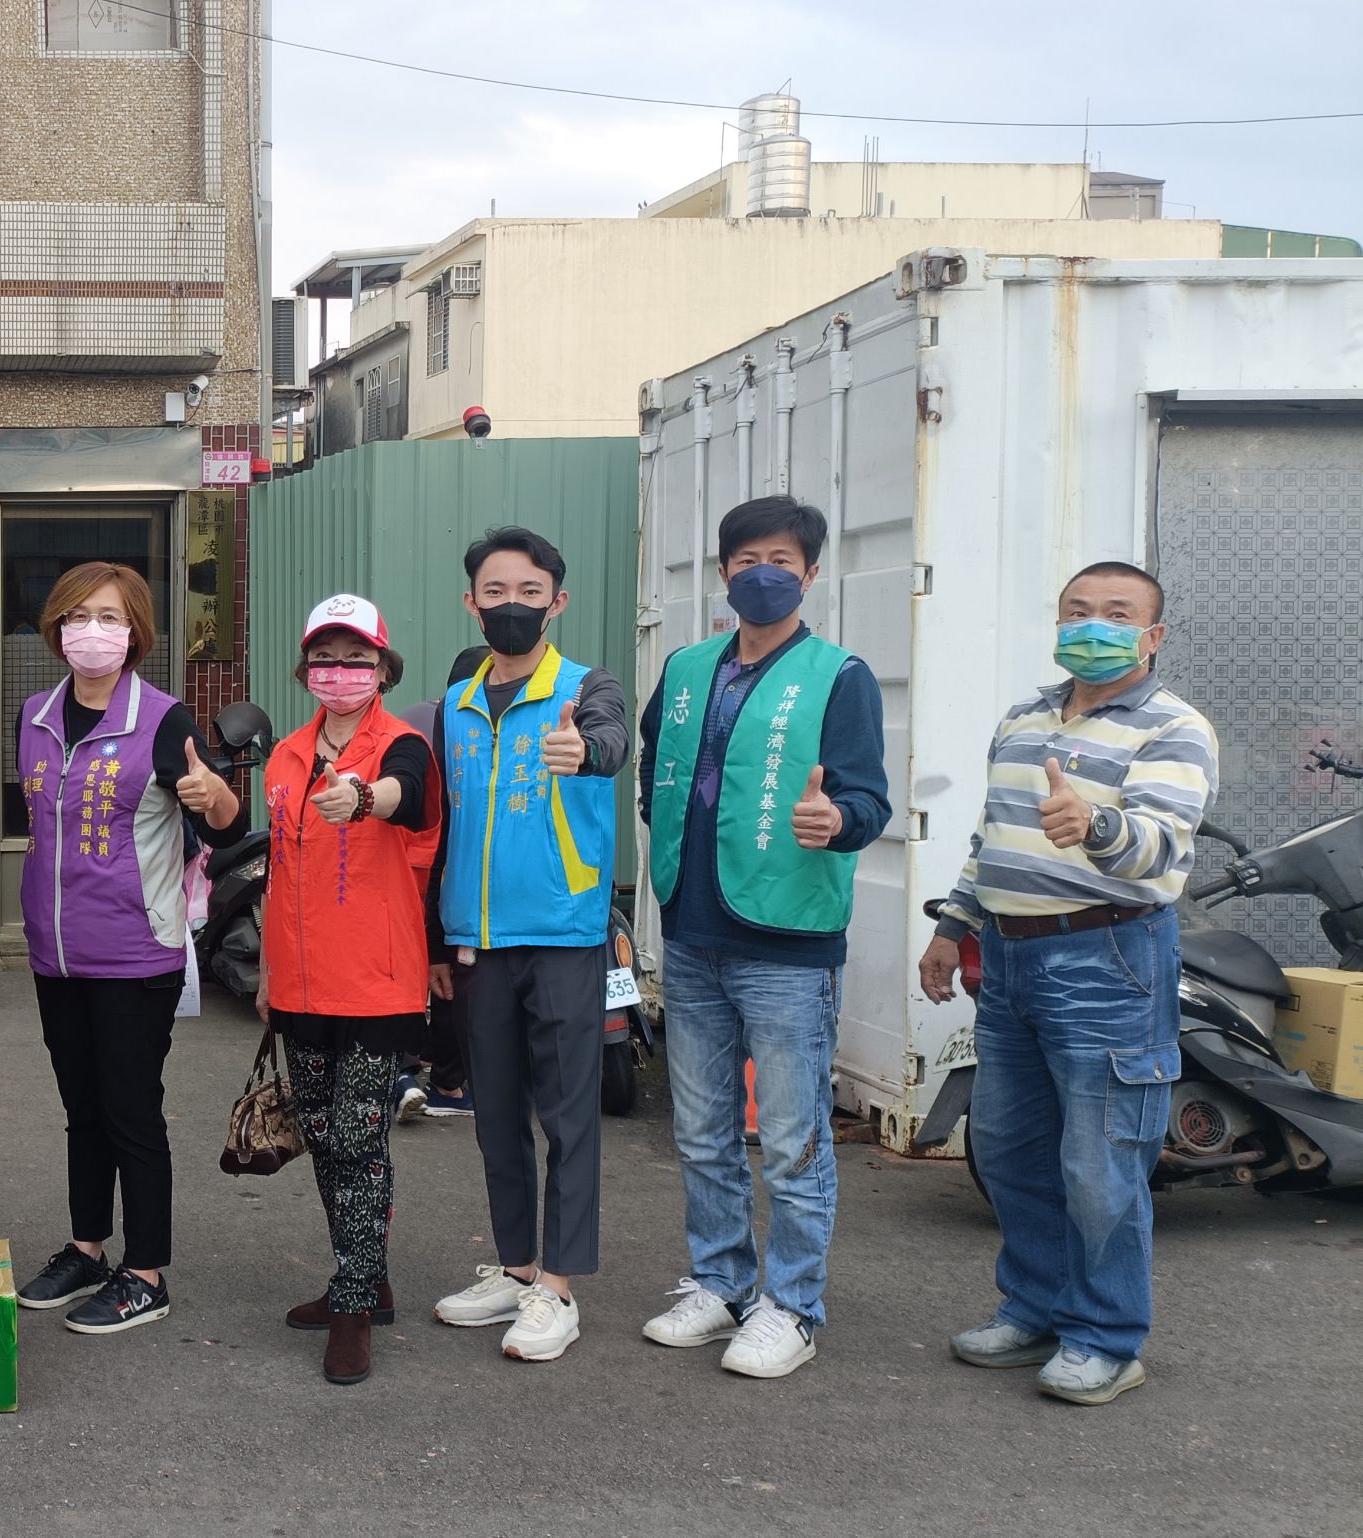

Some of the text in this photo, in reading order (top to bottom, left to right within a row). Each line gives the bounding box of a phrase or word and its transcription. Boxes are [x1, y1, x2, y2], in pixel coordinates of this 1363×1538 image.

[217, 465, 241, 481] 42
[197, 496, 210, 536] 龍潭區
[213, 497, 226, 536] 桃園市
[655, 687, 691, 788] 志工
[31, 759, 48, 793] 助理
[754, 684, 802, 851] 隆祥經濟發展基金會
[79, 758, 102, 856] 感恩服務團隊
[96, 759, 122, 857] 黃敬平議員
[607, 978, 635, 999] 635
[117, 1292, 153, 1320] FILA
